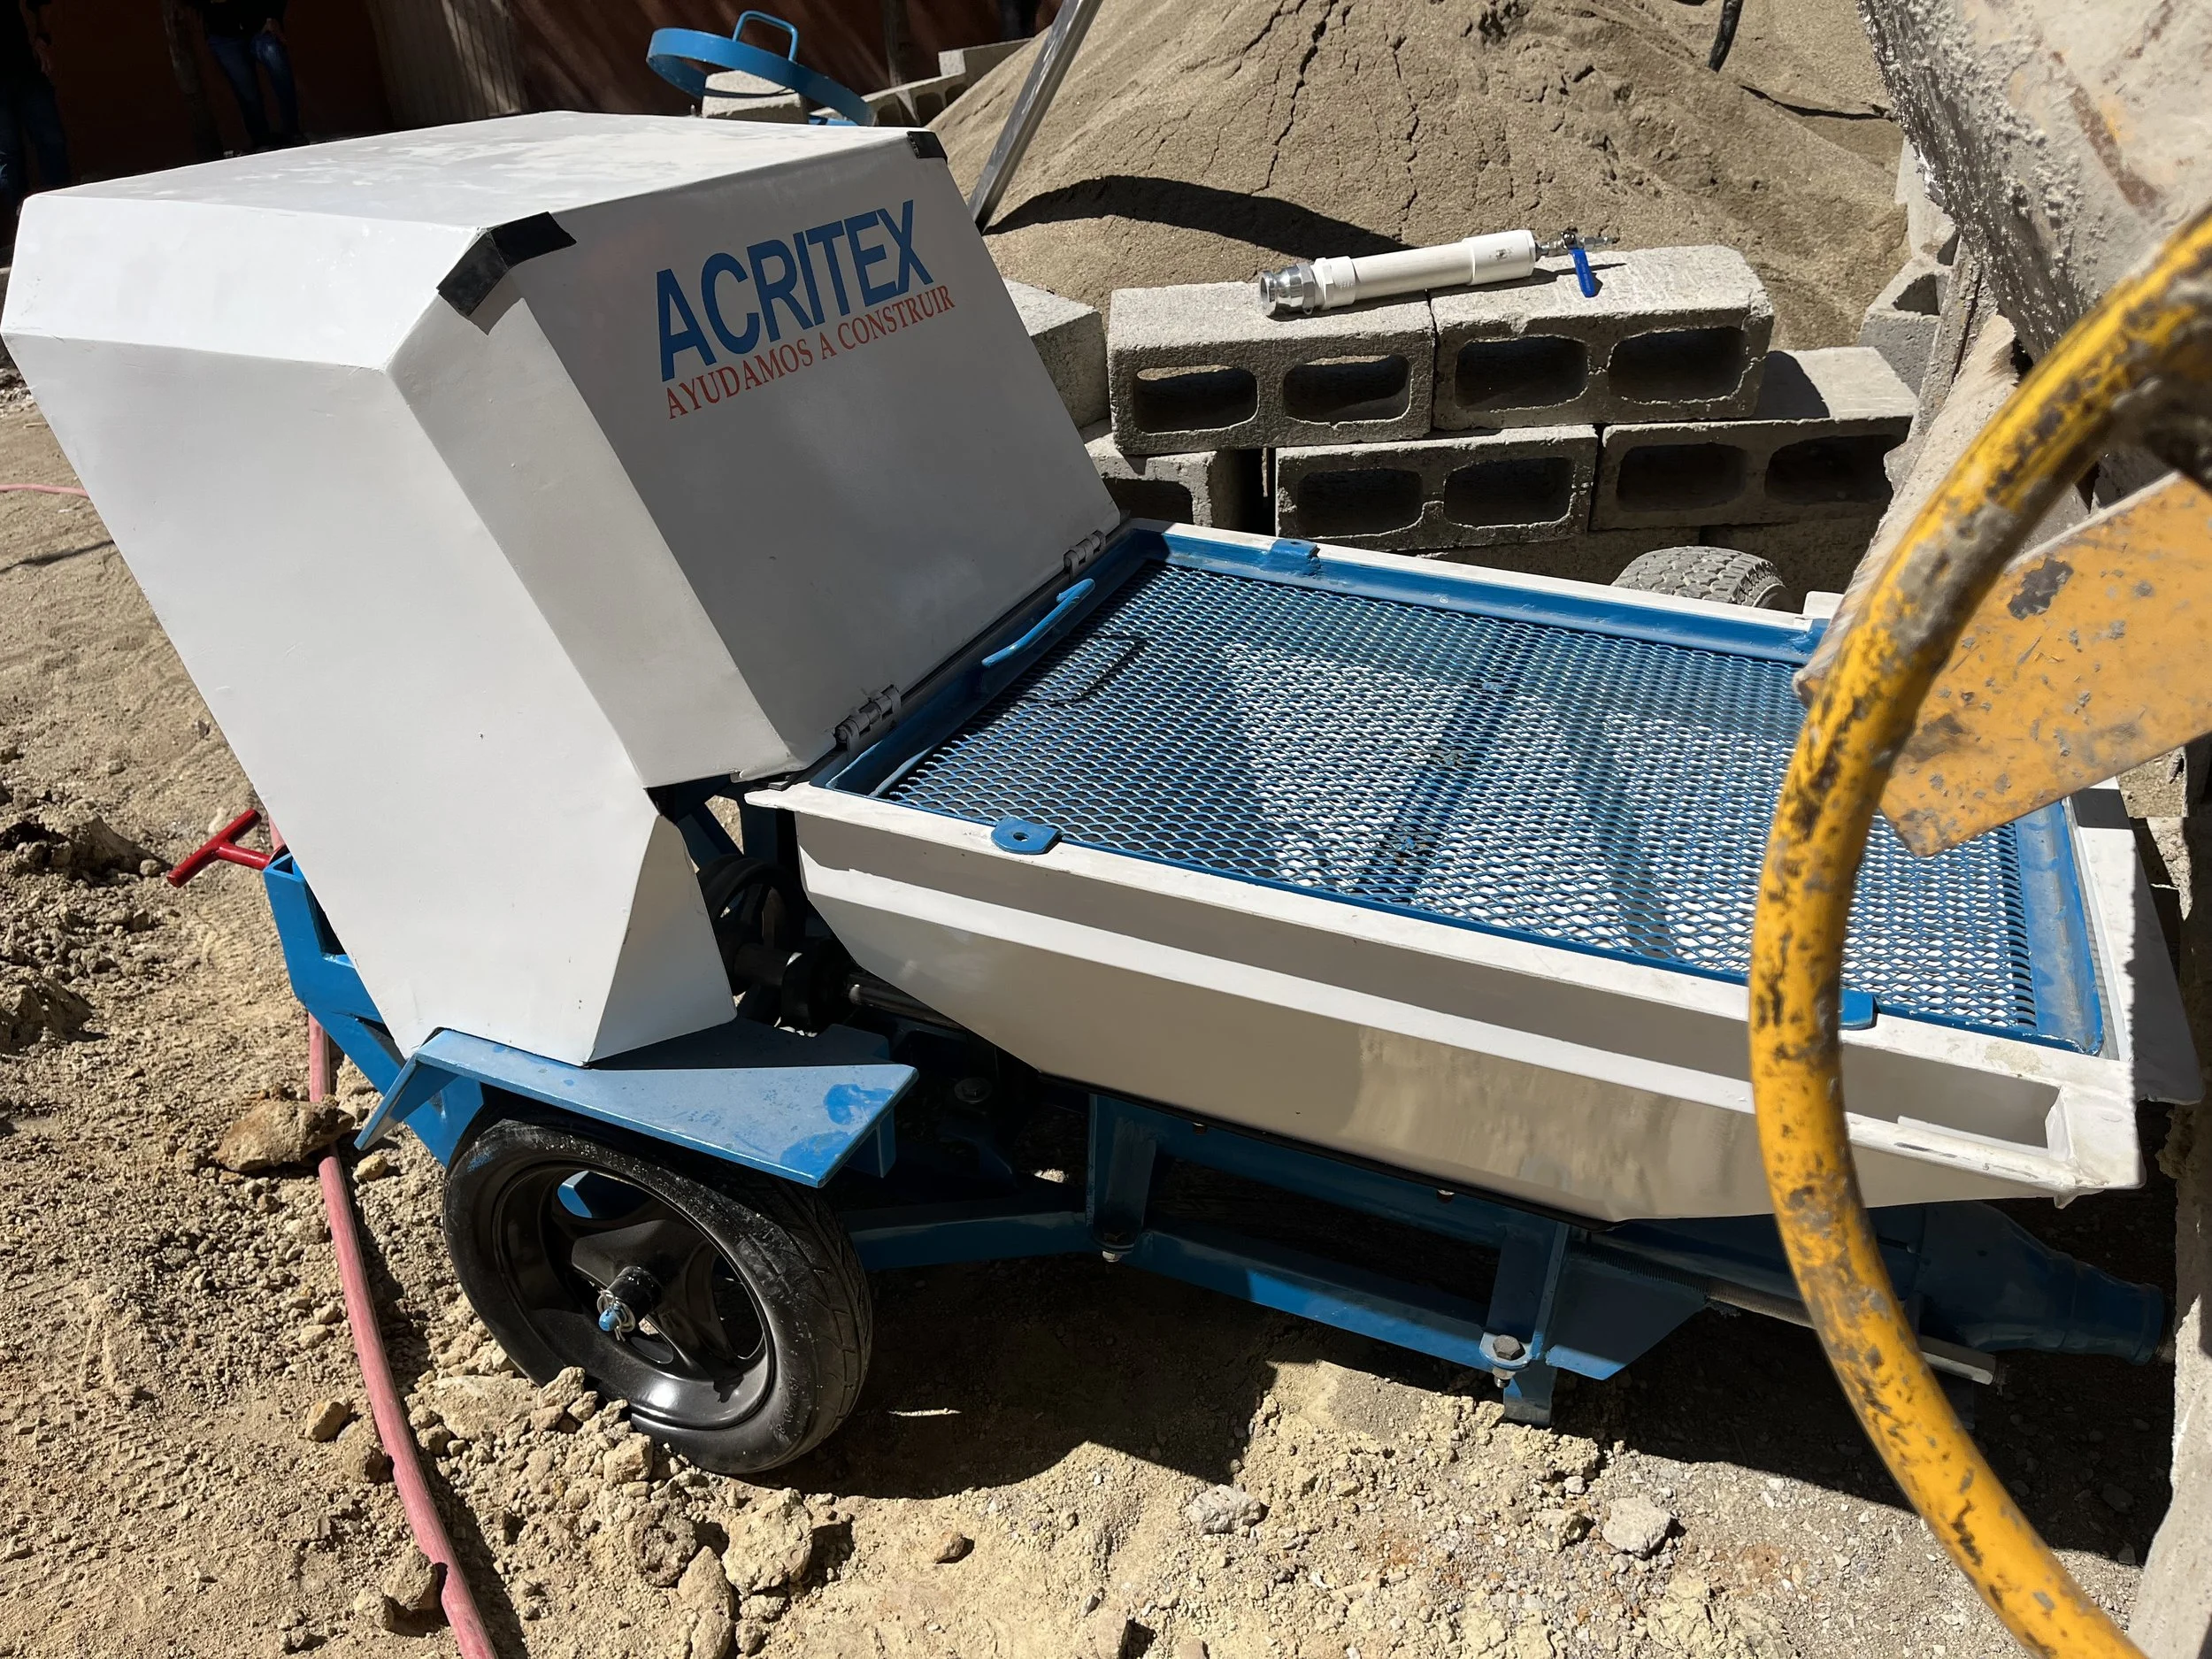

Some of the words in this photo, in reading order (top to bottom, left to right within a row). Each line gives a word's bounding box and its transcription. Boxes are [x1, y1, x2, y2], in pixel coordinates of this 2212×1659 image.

[657, 199, 934, 382] ACRITEX
[665, 338, 813, 420] AYUDAMOS
[819, 331, 837, 360] A
[837, 284, 956, 350] CONSTRUIR
